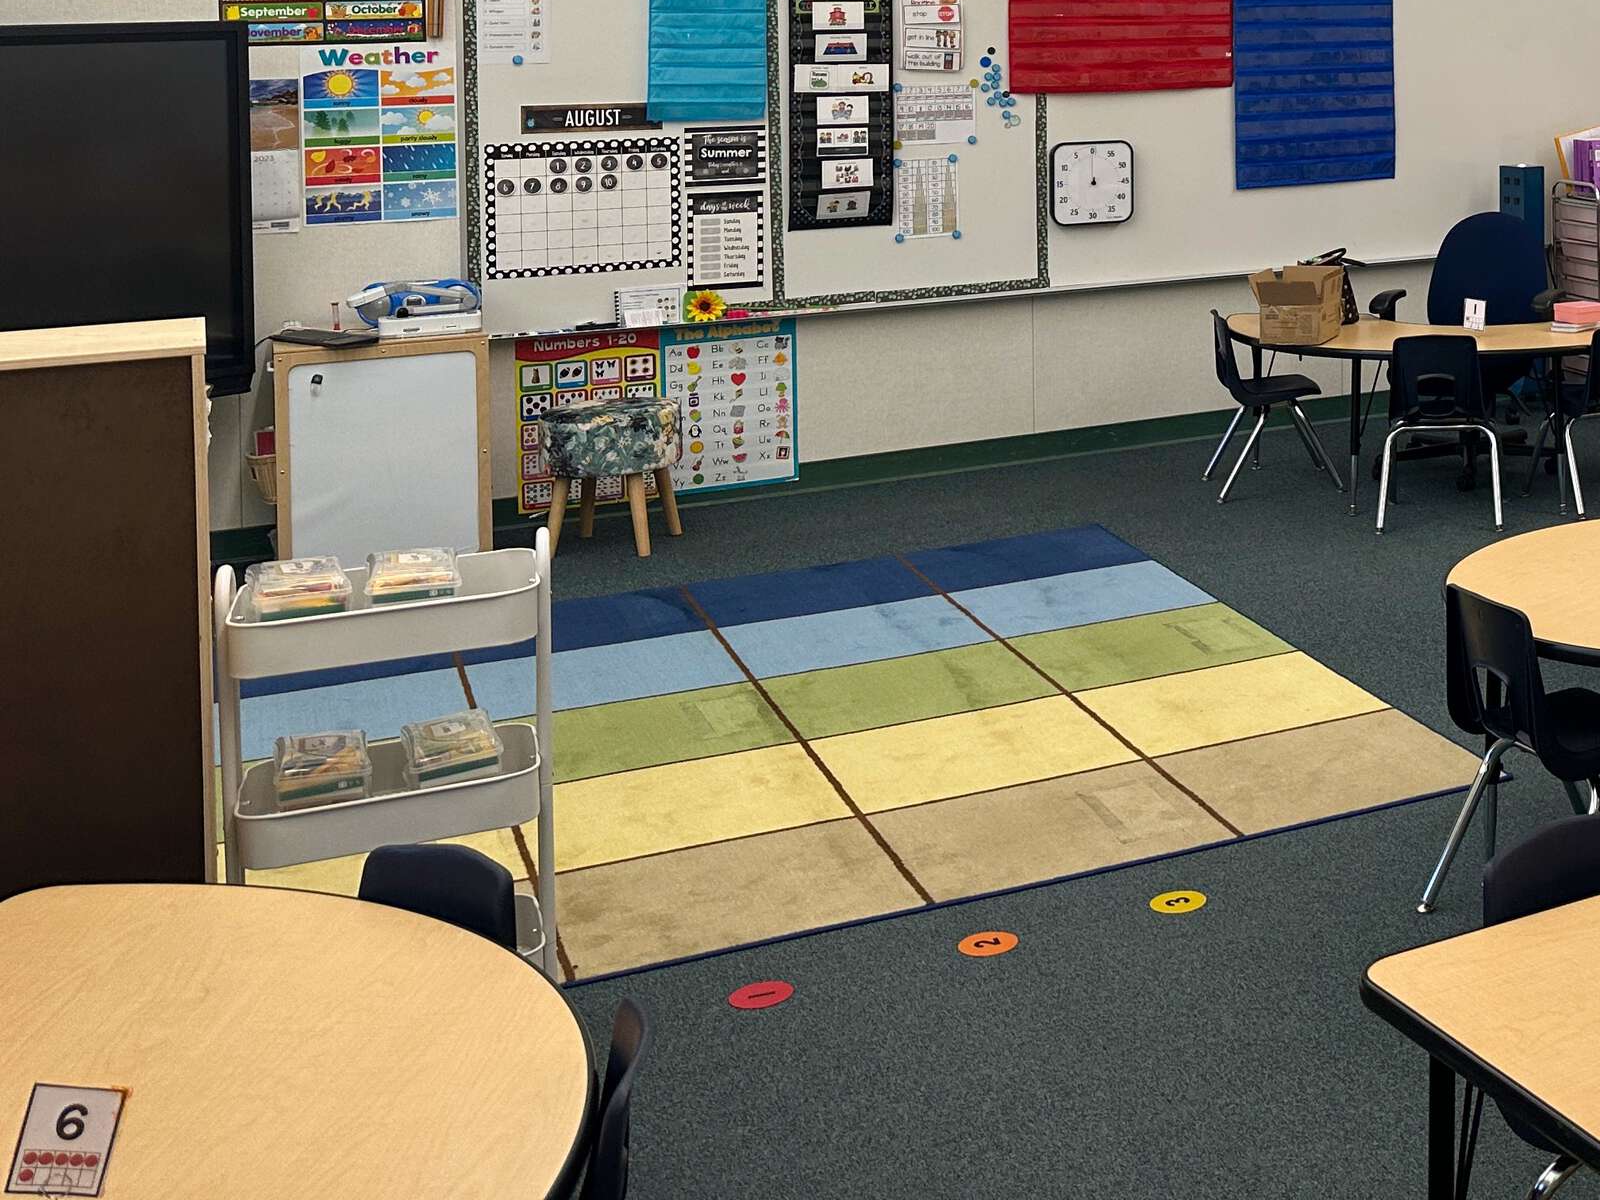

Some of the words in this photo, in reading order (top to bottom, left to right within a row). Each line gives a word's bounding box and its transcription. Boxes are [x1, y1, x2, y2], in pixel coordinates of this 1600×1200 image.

[240, 6, 307, 20] September
[351, 4, 398, 15] October
[248, 27, 302, 38] ovember
[318, 46, 440, 67] Weather
[564, 108, 622, 127] AUGUST
[700, 147, 752, 159] Summer
[728, 199, 751, 210] week
[533, 336, 601, 352] Numbers
[607, 333, 637, 346] 1-20
[1165, 896, 1191, 909] 3
[974, 936, 1000, 949] 2
[56, 1103, 89, 1141] 6
